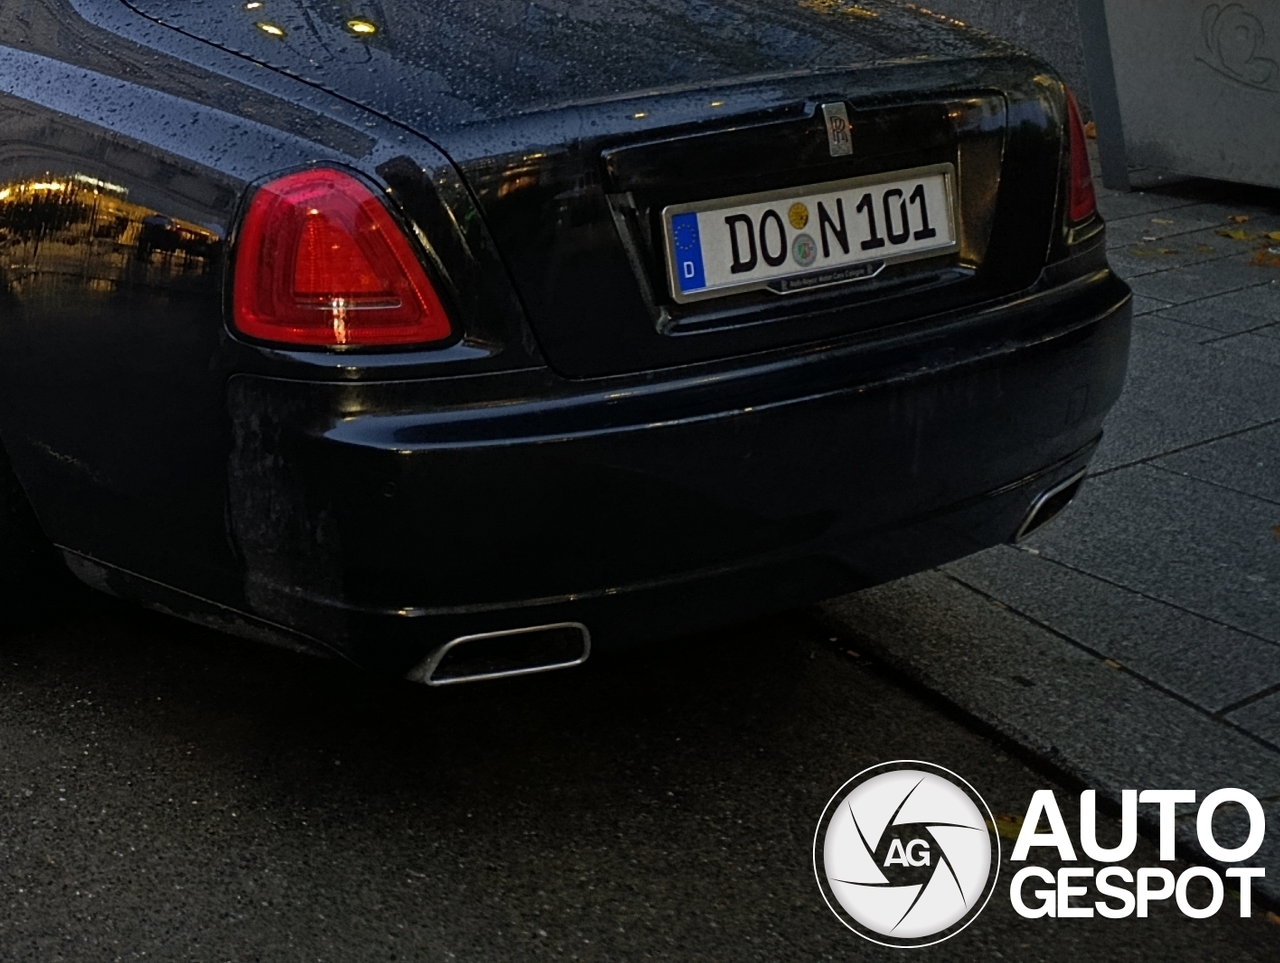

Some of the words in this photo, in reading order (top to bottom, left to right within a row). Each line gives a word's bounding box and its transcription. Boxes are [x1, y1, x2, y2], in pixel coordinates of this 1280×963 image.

[725, 209, 788, 275] DO
[817, 198, 850, 258] N
[856, 184, 936, 251] 101
[683, 261, 695, 278] D
